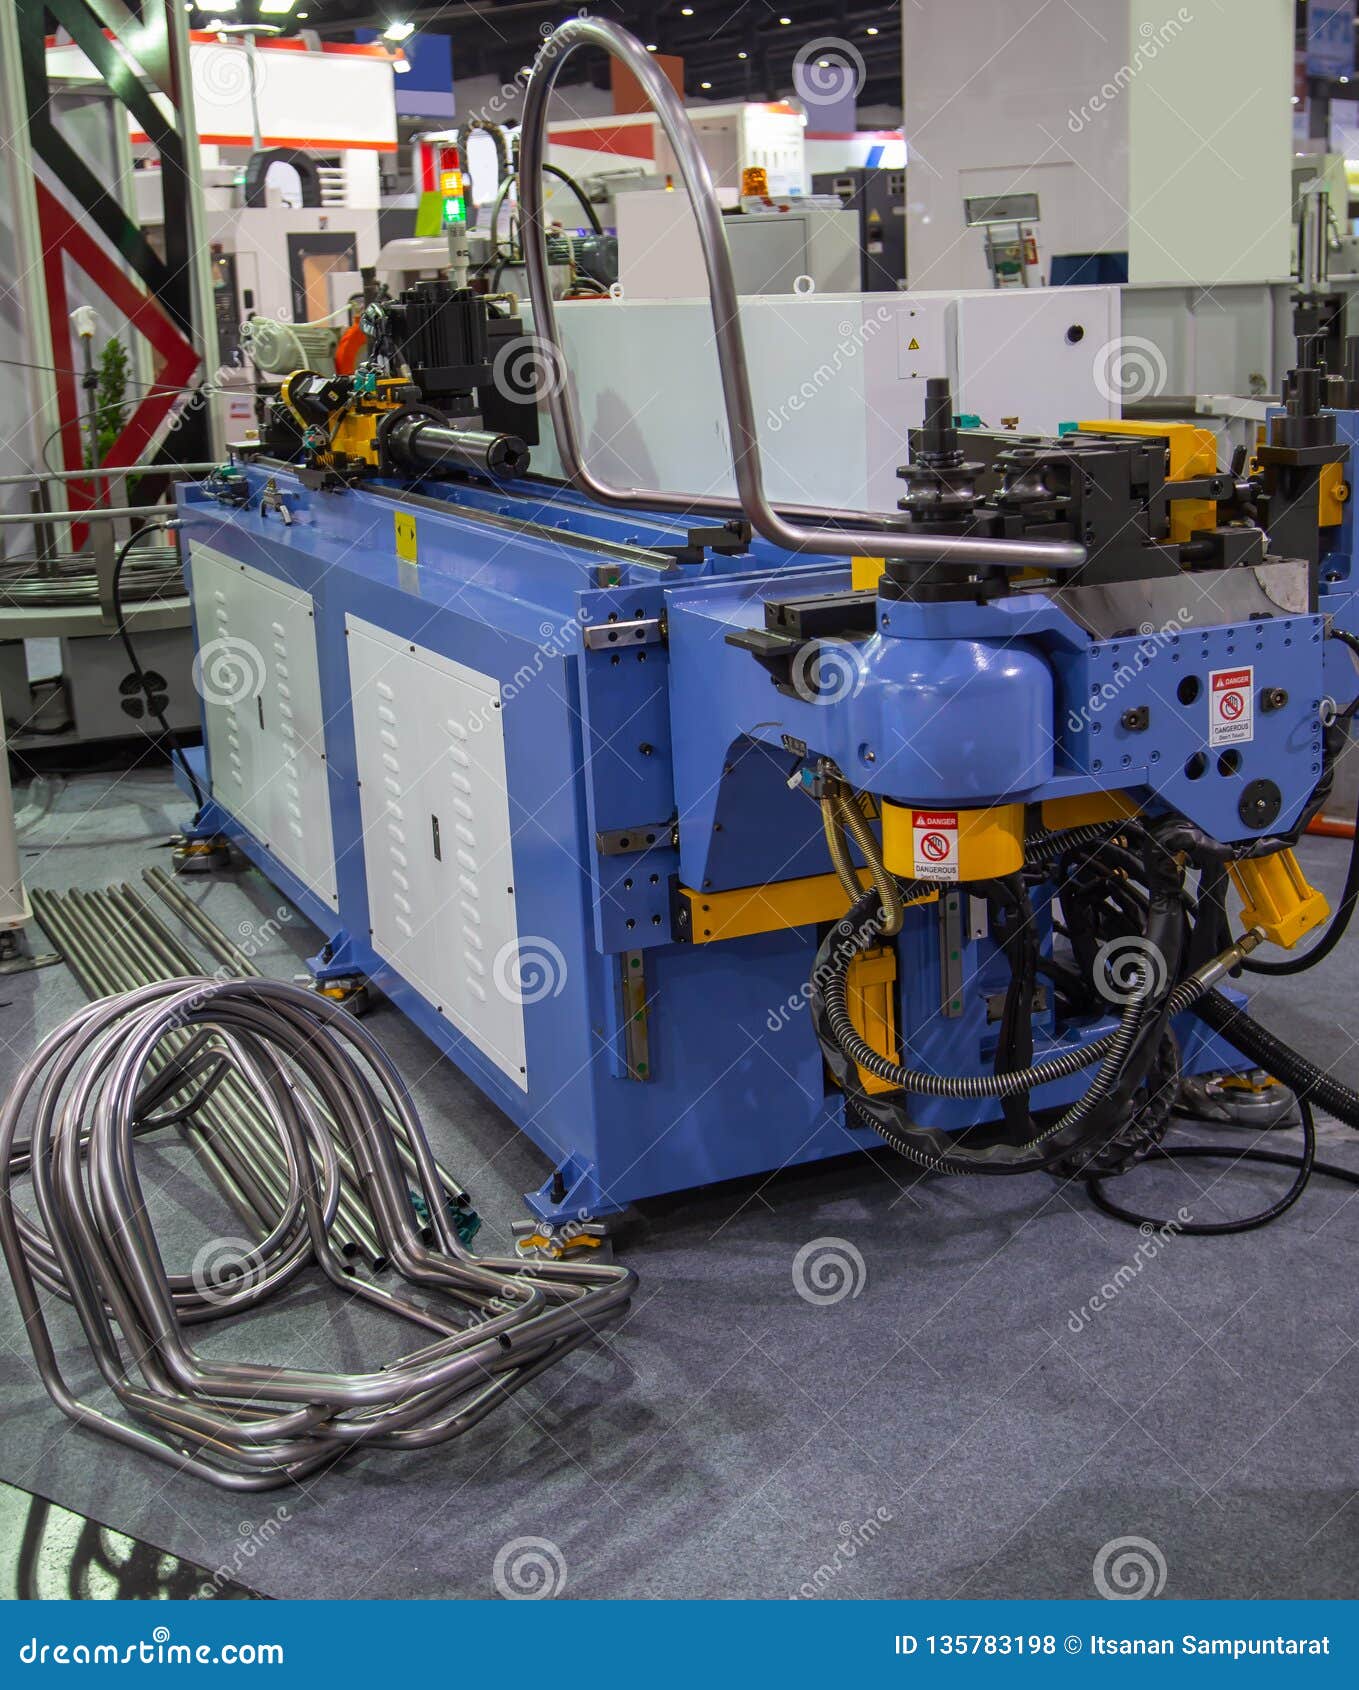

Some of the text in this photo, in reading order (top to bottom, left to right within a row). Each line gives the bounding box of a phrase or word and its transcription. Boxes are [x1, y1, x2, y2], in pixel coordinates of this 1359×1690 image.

[1225, 675, 1249, 685] DANGER
[1215, 722, 1249, 734] DANGEROUS
[927, 817, 956, 825] DANGER
[916, 865, 956, 874] DANGEROUS
